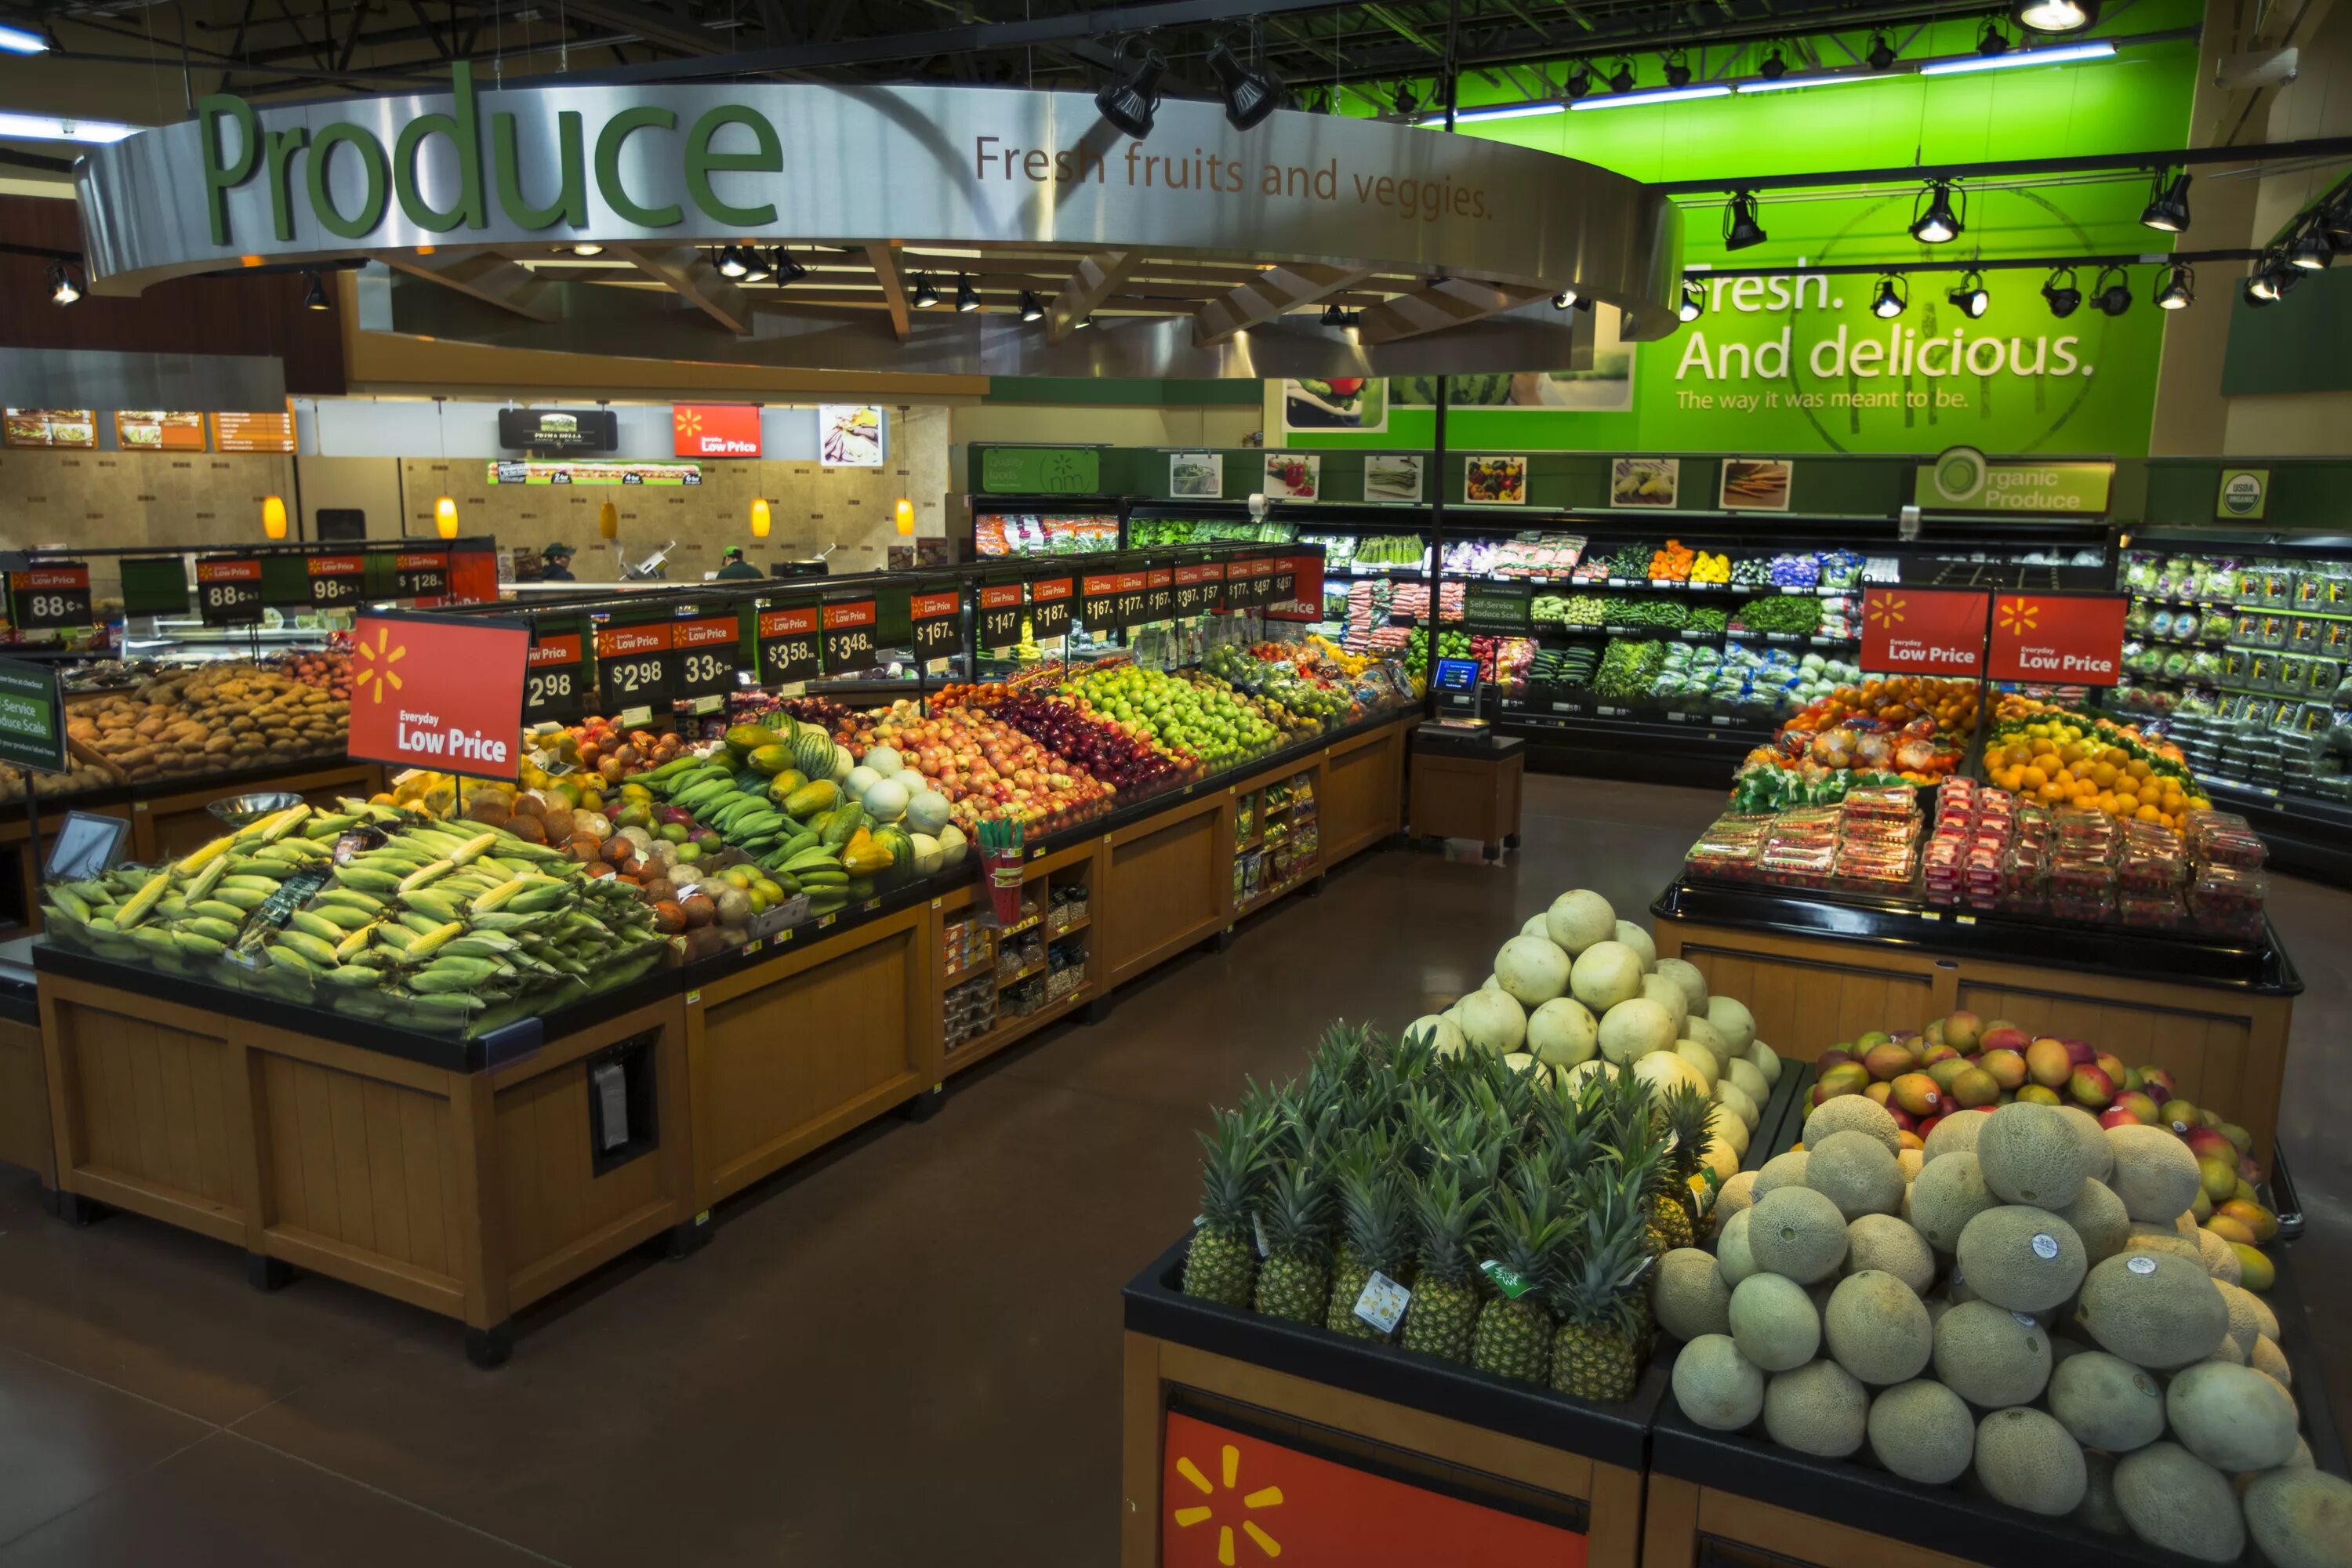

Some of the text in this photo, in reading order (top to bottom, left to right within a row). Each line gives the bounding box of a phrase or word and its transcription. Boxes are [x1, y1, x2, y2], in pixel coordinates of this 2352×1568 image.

[199, 61, 783, 246] Produce
[976, 136, 1493, 222] Fresh fruits and veggies.
[1675, 323, 2094, 380] And delicious.
[1676, 387, 1969, 413] The way it was meant to be.
[702, 441, 757, 452] Low Price
[1985, 489, 2080, 509] Produce
[1054, 586, 1065, 594] Price
[1229, 583, 1247, 599] $177
[1254, 579, 1270, 595] $497
[1002, 593, 1014, 602] Price
[1119, 596, 1141, 615] $177
[1149, 592, 1169, 610] $167
[1178, 588, 1196, 608] $397
[1469, 601, 1514, 610] Self-Service
[925, 602, 950, 612] Low Price
[1087, 600, 1110, 620] $167
[1287, 599, 1315, 614] ice
[1469, 609, 1500, 618] Produce
[837, 612, 866, 623] Low Price
[1037, 604, 1065, 626] $187
[775, 619, 808, 631] Low Price
[617, 635, 659, 650] Low Price
[689, 628, 727, 641] Low Price
[1890, 639, 1922, 648] Everyday
[2021, 646, 2054, 655] Everyday
[528, 647, 567, 661] ow Price
[769, 641, 808, 669] $358
[1889, 644, 1975, 663] Low Price
[2020, 652, 2112, 672] Low Price
[613, 660, 662, 691] $298
[529, 674, 571, 707] 298
[400, 710, 439, 727] Everyday
[23, 719, 46, 735] Scale
[398, 722, 506, 763] Low Price
